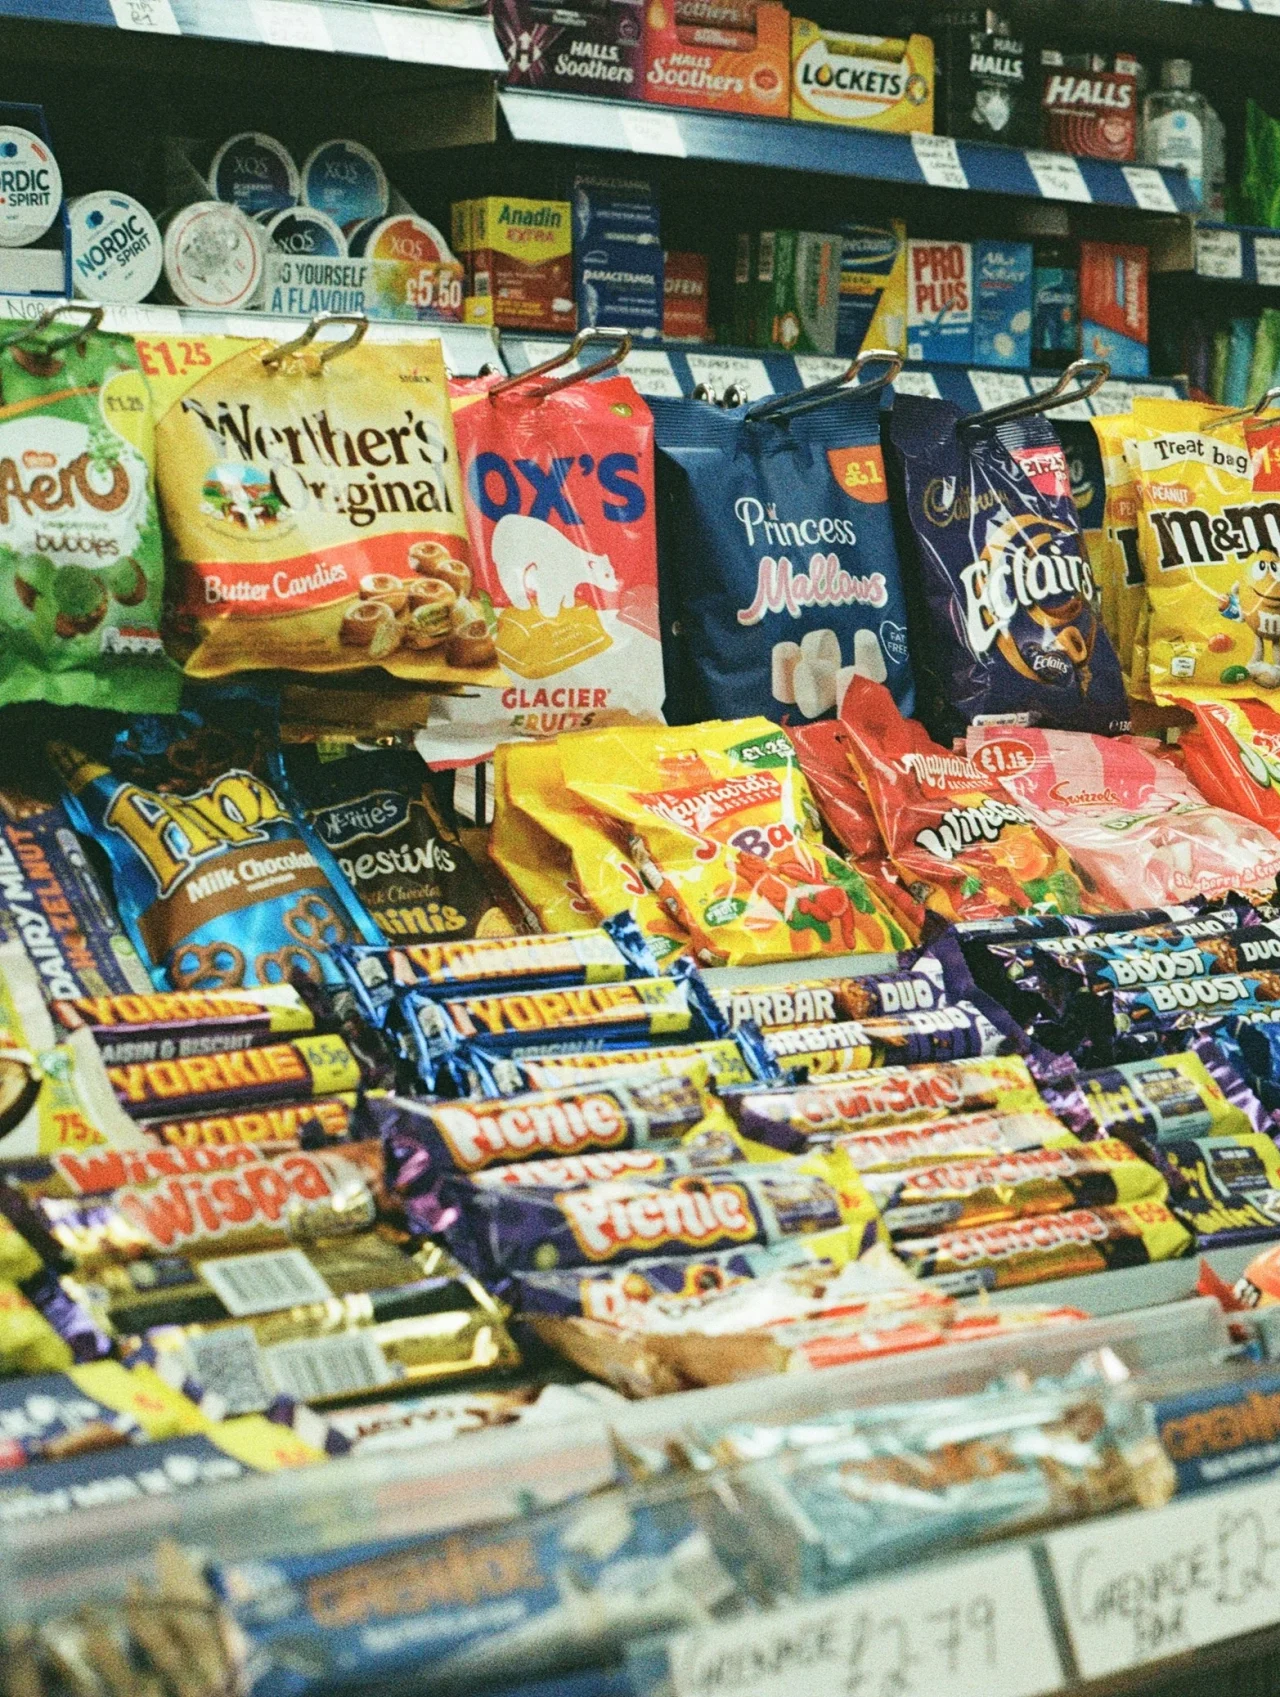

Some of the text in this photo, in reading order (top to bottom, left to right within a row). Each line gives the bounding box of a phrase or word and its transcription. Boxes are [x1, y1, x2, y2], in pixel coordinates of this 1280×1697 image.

[570, 41, 618, 62] HALLS
[670, 52, 711, 70] HALLS
[970, 54, 1024, 80] HALLS
[555, 54, 634, 84] Soothers
[647, 58, 744, 93] Soothers
[802, 63, 901, 96] LOCKETS
[1047, 75, 1132, 109] HALLS
[0, 168, 50, 192] RDIC
[8, 192, 50, 207] SPIRIT
[497, 204, 562, 228] Anadin
[74, 214, 146, 279] NORDIC
[115, 232, 152, 268] SPIRIT
[912, 244, 966, 282] PRO
[297, 262, 368, 287] YOURSELF
[664, 278, 703, 295] OFEN
[271, 287, 365, 314] A FLAVOUR
[916, 281, 969, 313] PLUS
[181, 398, 448, 468] Werther's
[1154, 438, 1249, 474] Treat bag
[473, 452, 647, 526] OX'S
[844, 460, 882, 488] £1
[1151, 484, 1190, 503] PEANUT
[734, 496, 857, 548] Princess
[34, 530, 119, 557] bubbles
[204, 562, 348, 604] Butter Candies
[737, 552, 888, 626] Mallows
[960, 545, 1094, 655] Eclairs
[500, 687, 609, 710] GLACIER
[508, 712, 596, 731] FRUITS
[980, 745, 1028, 772] £1.15
[186, 865, 239, 903] Milk
[1176, 917, 1223, 938] DUO
[9, 902, 82, 1000] DAIRY
[1111, 947, 1204, 986] BOOST
[466, 984, 641, 1034] YORKIE
[719, 977, 935, 1029] TARBAR DUO
[1148, 976, 1251, 1012] BOOST
[913, 1006, 973, 1034] DUO
[101, 1040, 157, 1063] AISIN
[179, 1033, 255, 1057] BISCUIT
[108, 1042, 307, 1102] YORKIE
[438, 1093, 629, 1168] Picnic
[115, 1156, 331, 1249] Wispa
[568, 1180, 750, 1260] Picnic
